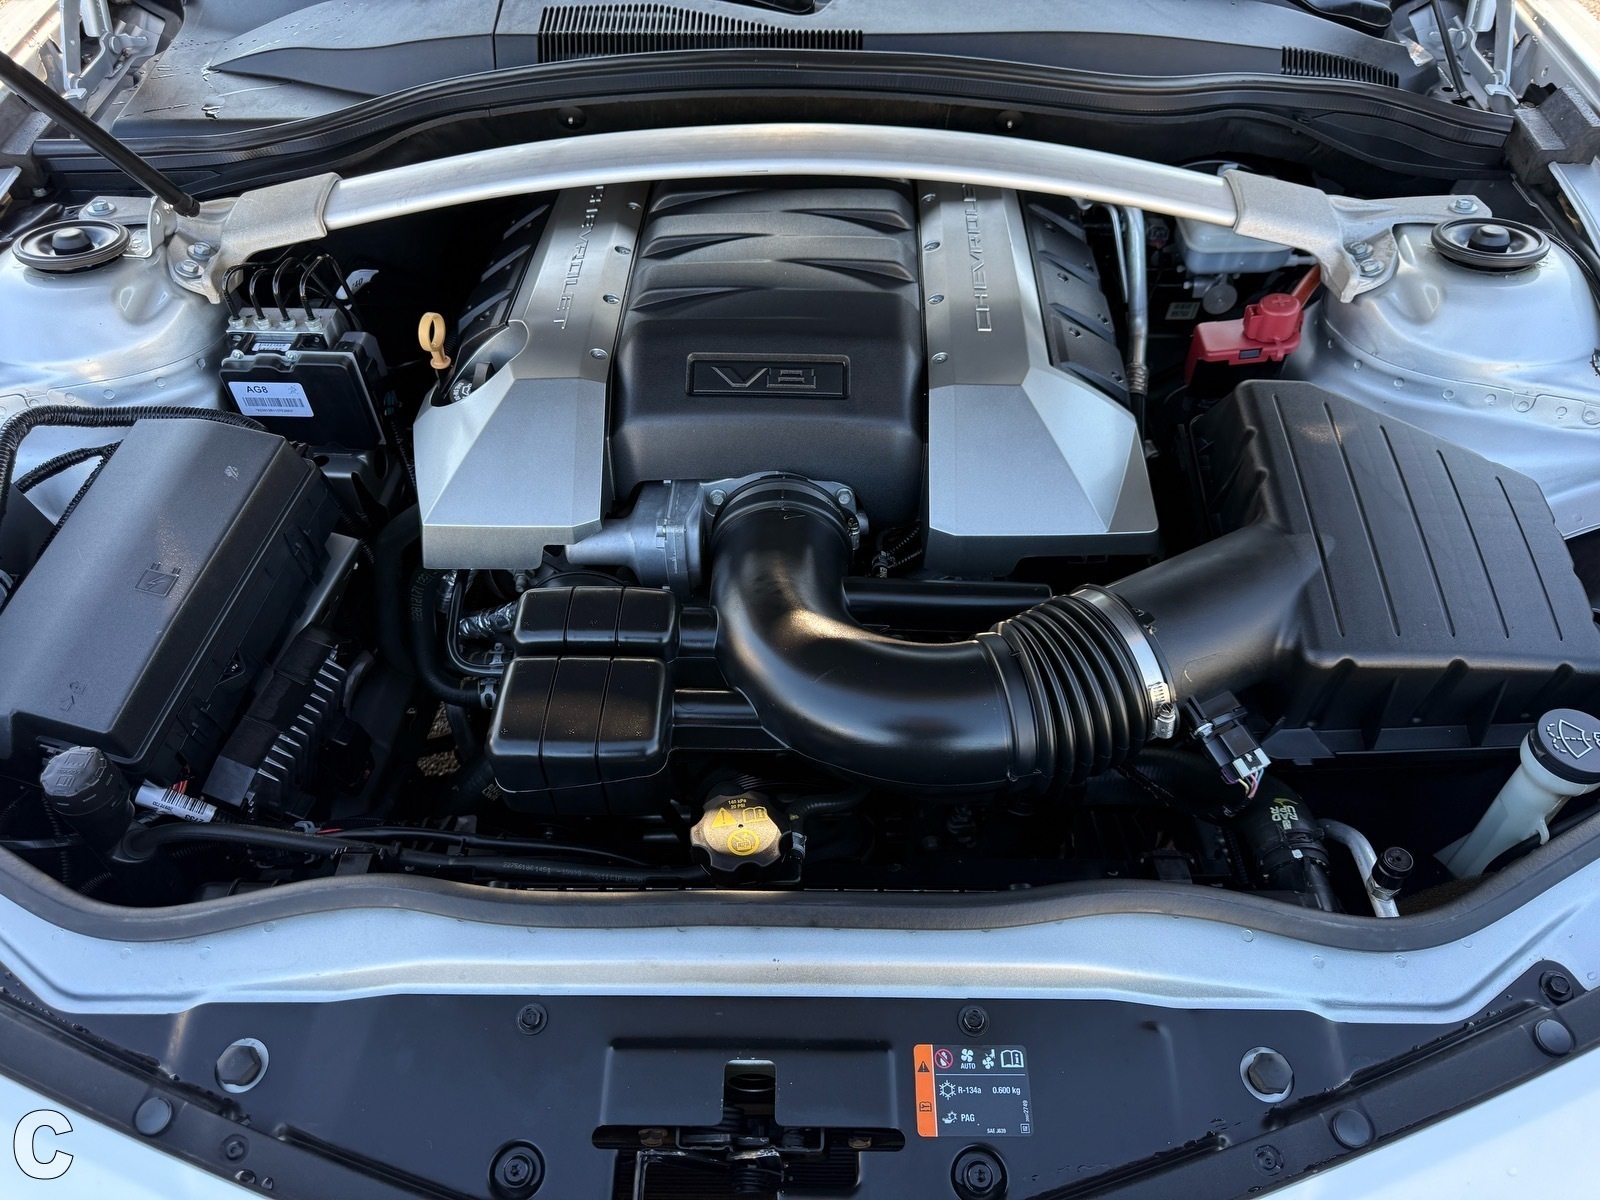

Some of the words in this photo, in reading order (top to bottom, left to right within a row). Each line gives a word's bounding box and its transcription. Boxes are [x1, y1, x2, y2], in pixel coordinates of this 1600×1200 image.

[553, 186, 604, 330] CHEVROLET
[962, 184, 993, 332] CHEVROLE
[711, 366, 817, 389] V8
[246, 386, 269, 394] AG8
[1271, 812, 1299, 822] RAD
[960, 1062, 976, 1070] AUTO
[958, 1086, 982, 1094] R-134a
[992, 1086, 1011, 1094] 0.600
[1012, 1086, 1021, 1096] kg
[960, 1113, 975, 1122] PAG
